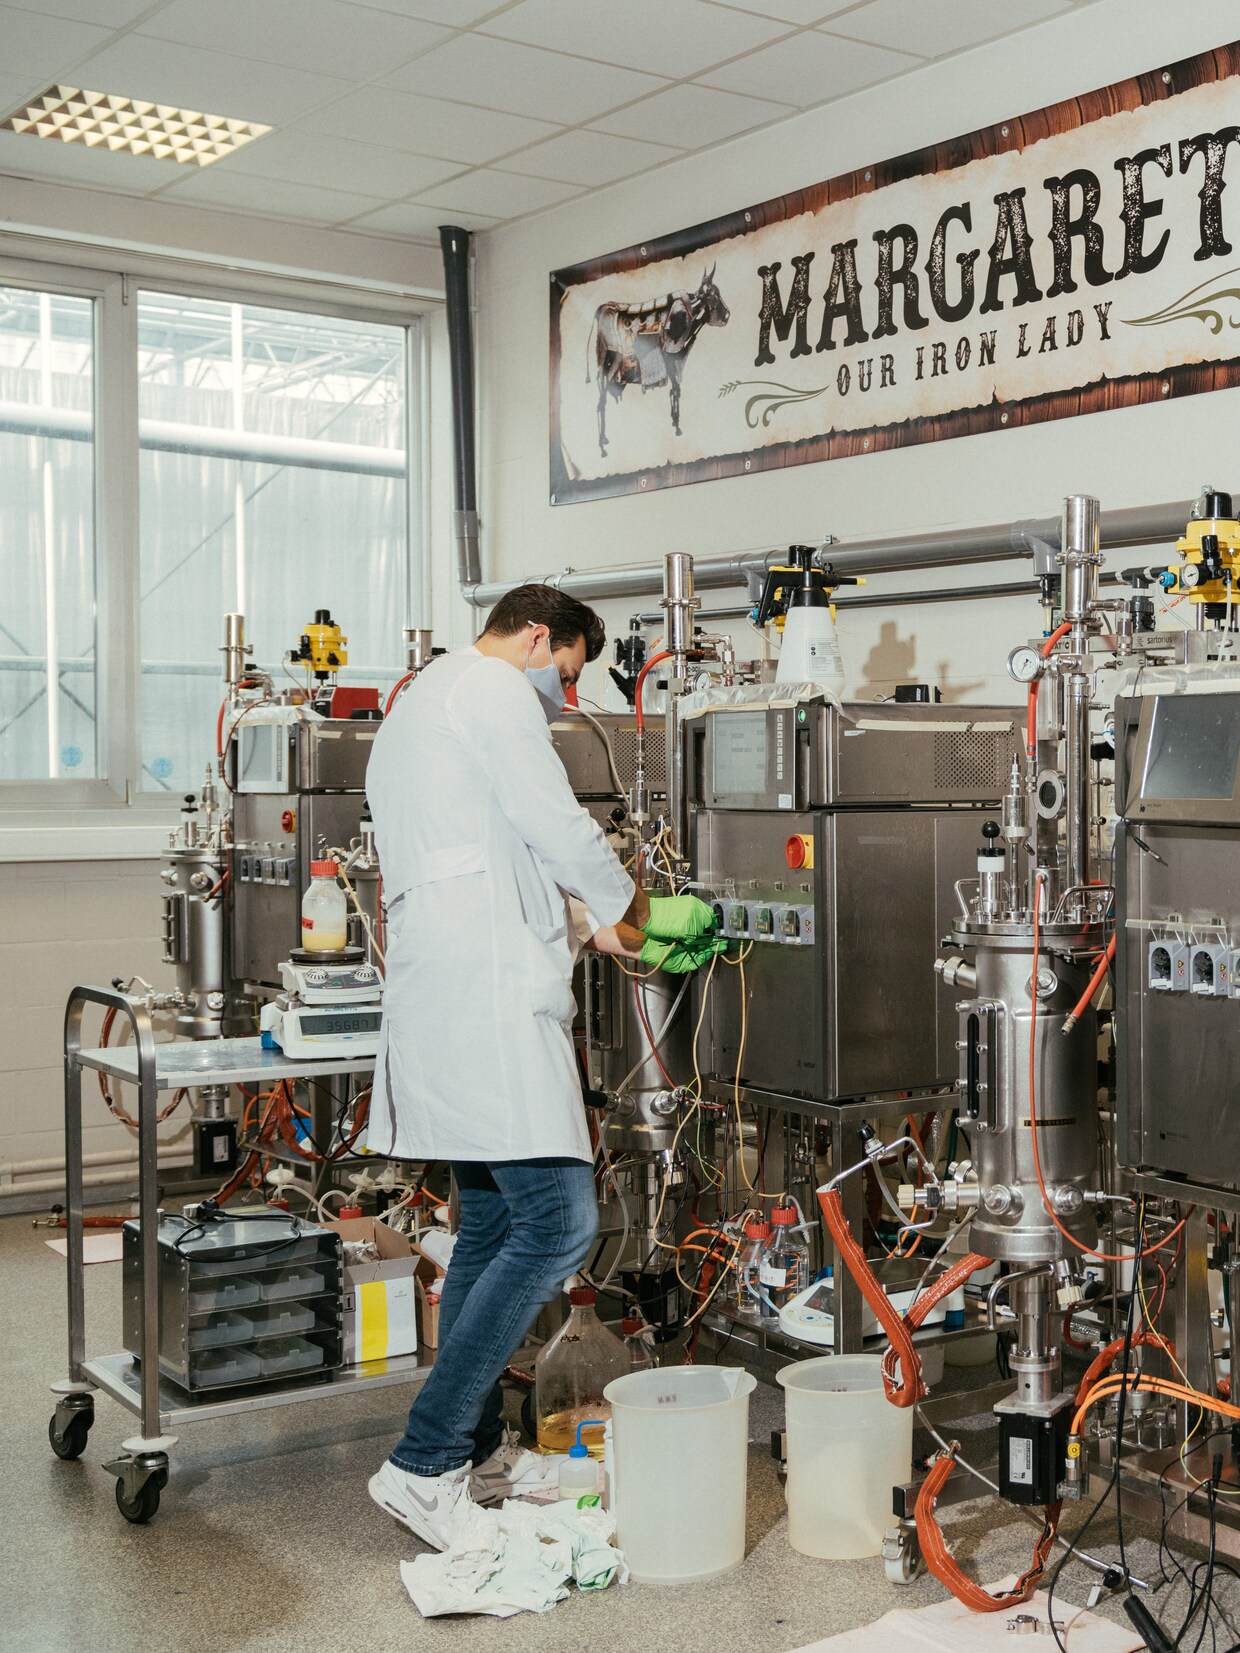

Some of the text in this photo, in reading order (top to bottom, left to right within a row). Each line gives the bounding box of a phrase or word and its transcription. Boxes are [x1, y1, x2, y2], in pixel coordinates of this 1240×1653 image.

[836, 301, 1115, 397] OUR IRON LADY
[1147, 636, 1172, 645] sartorius
